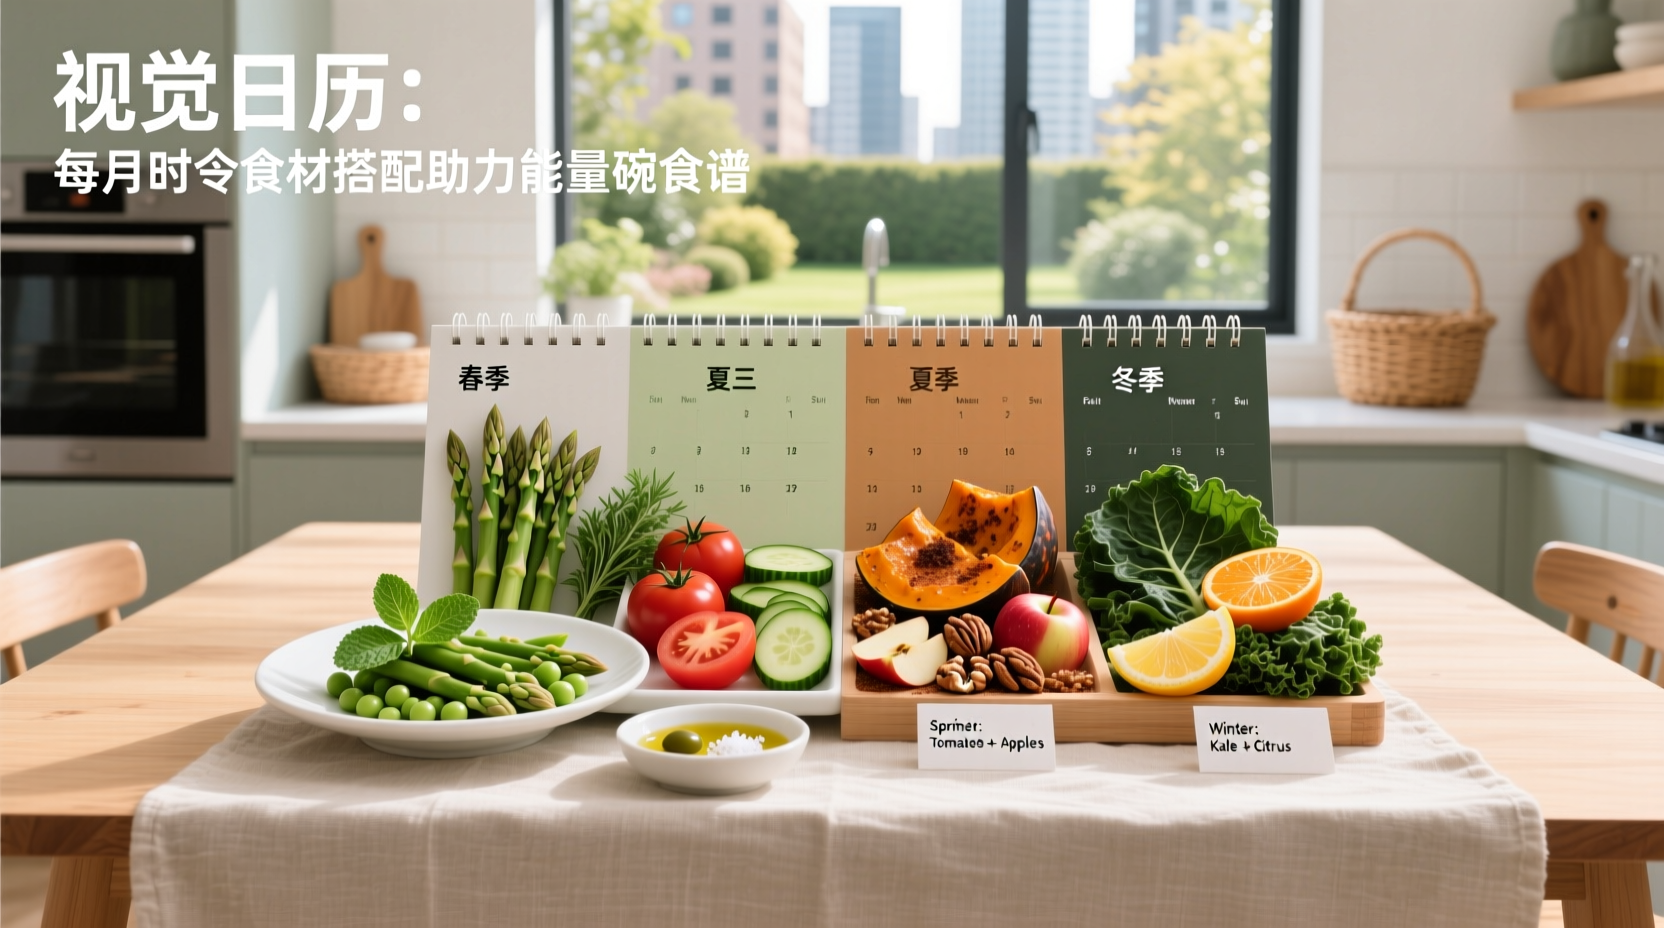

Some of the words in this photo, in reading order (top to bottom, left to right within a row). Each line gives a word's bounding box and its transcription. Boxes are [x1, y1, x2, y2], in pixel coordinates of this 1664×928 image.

[458, 365, 510, 392] 春季
[706, 366, 757, 392] 夏三
[909, 366, 960, 393] 夏季
[1112, 366, 1165, 394] 冬季
[1208, 721, 1259, 736] Winter:
[986, 738, 998, 748] +
[1000, 735, 1045, 753] Apples
[1210, 738, 1238, 752] Kale
[1254, 739, 1292, 753] Citrus
